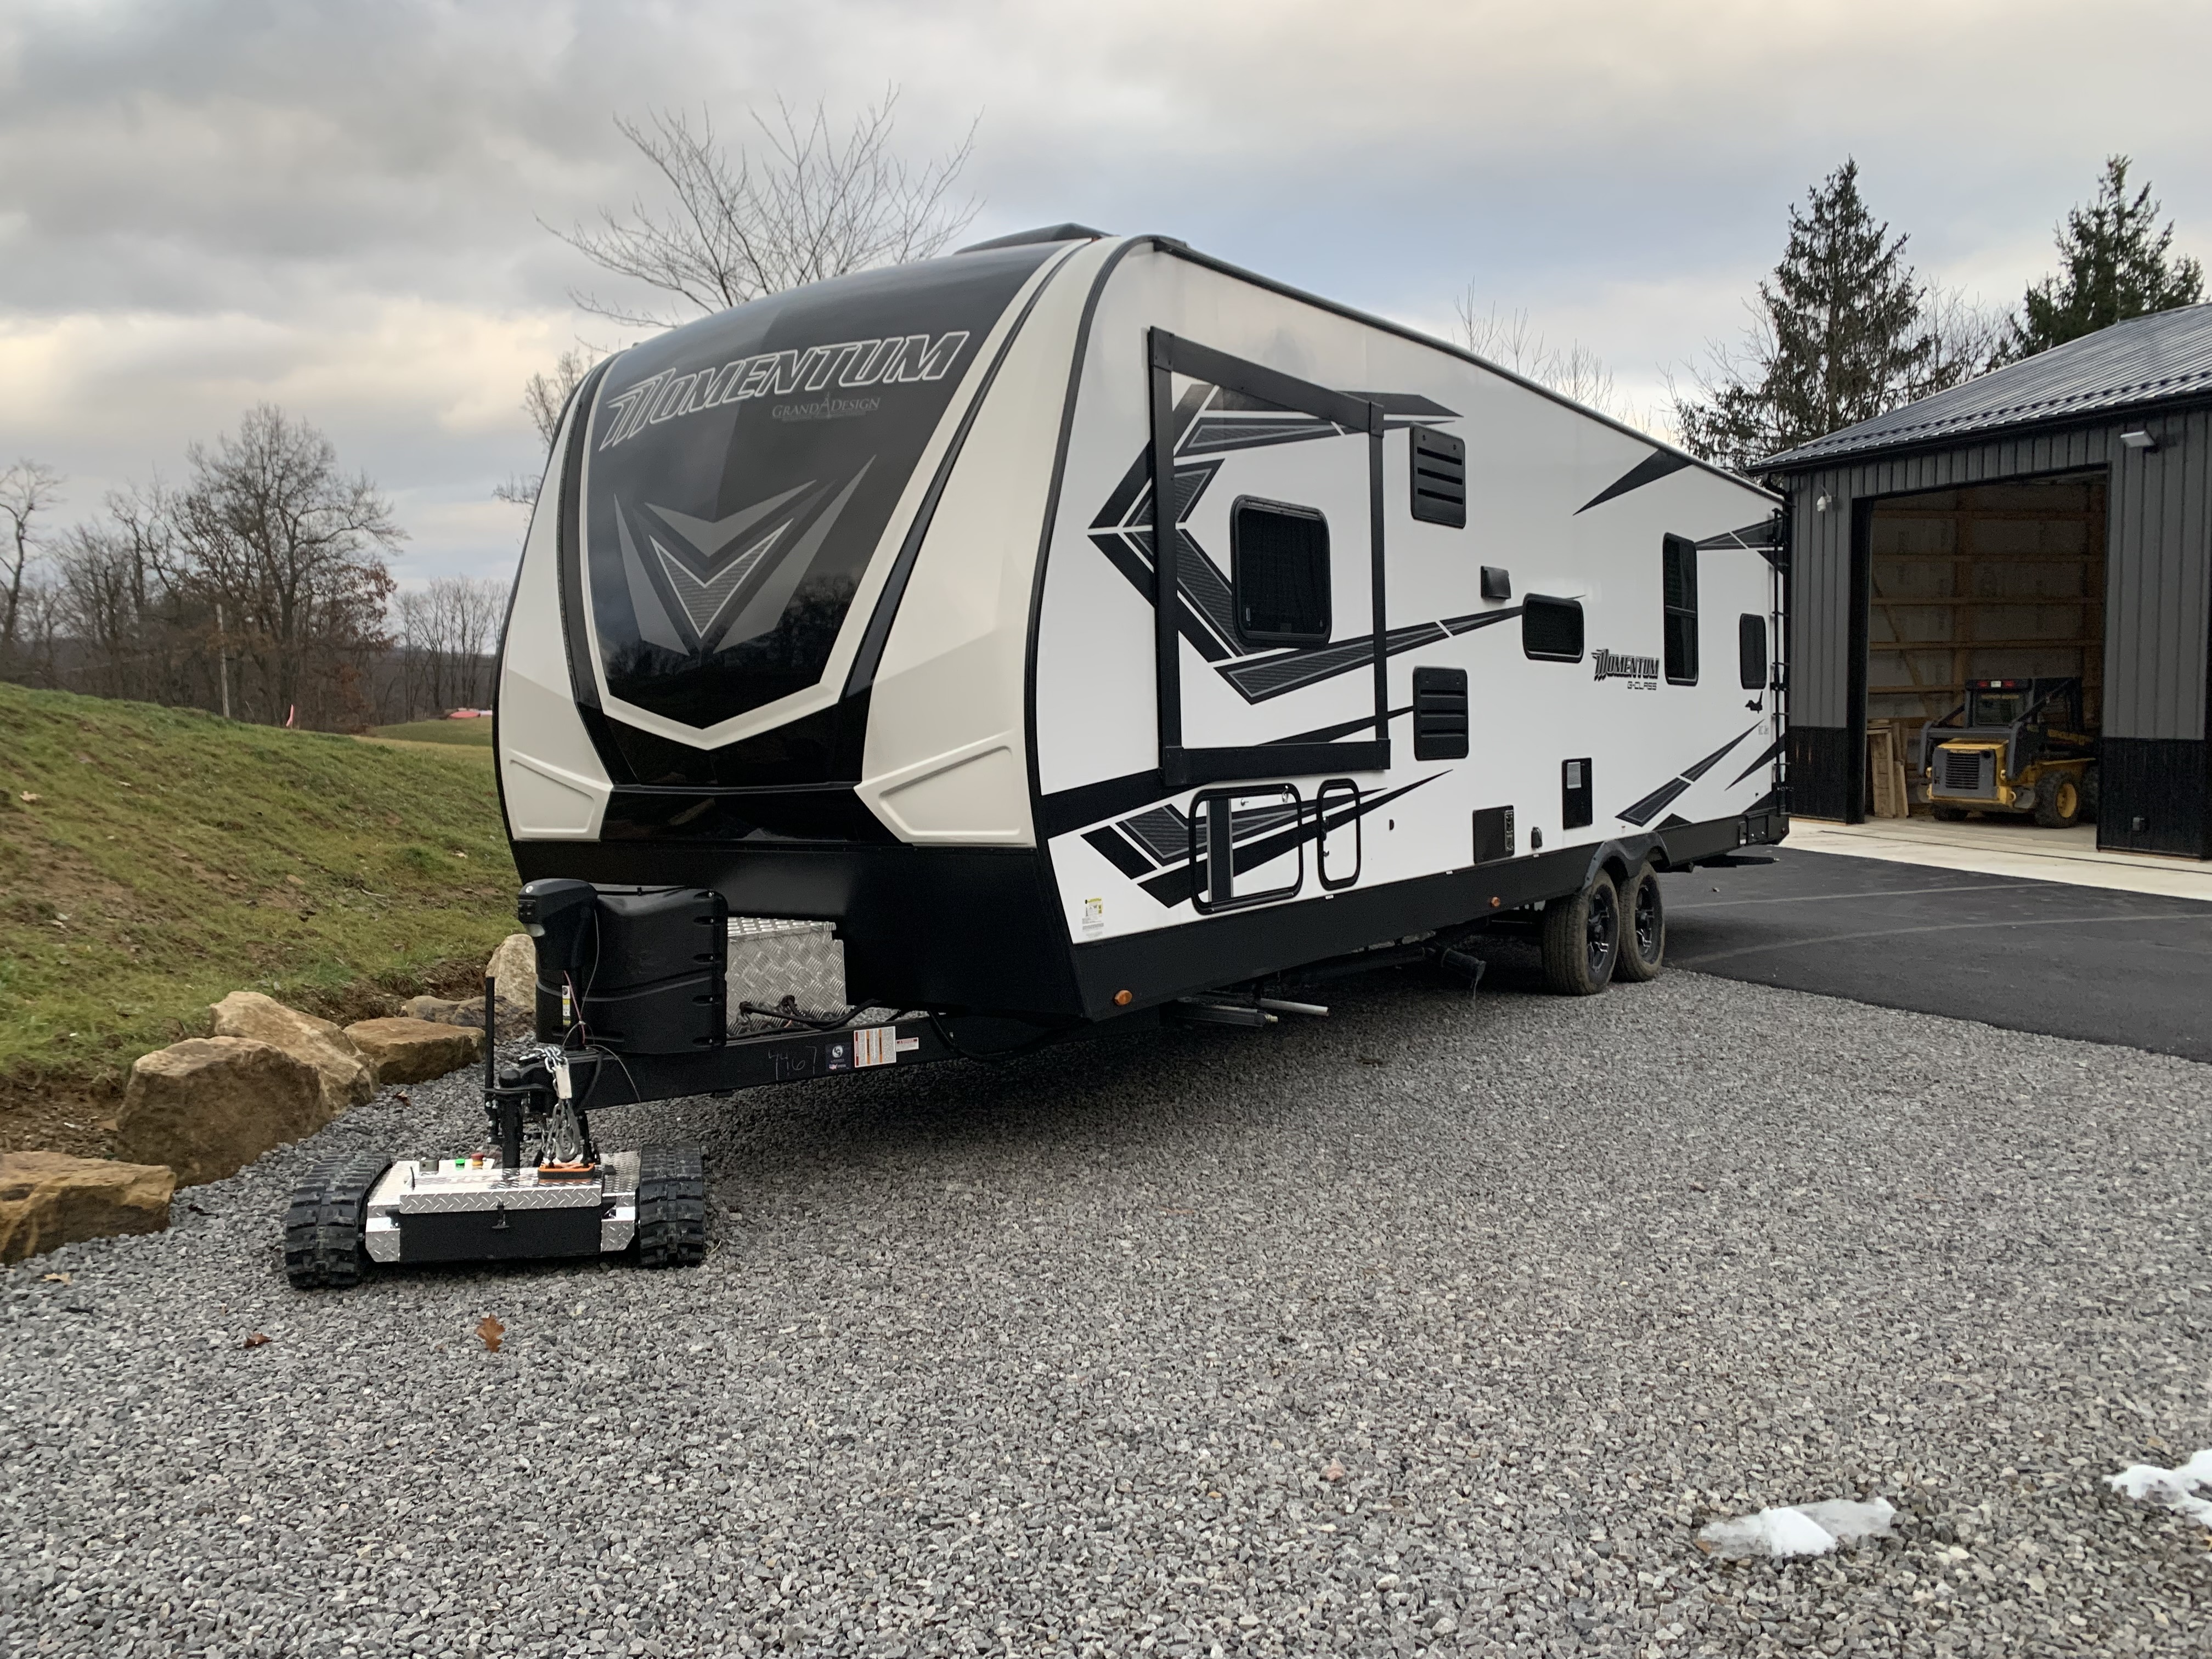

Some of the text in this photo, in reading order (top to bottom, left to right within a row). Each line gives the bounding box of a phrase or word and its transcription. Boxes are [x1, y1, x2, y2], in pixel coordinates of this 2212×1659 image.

[599, 331, 969, 452] MOMENTUM
[772, 402, 821, 419] GRAND
[831, 397, 881, 411] DESIGN
[1591, 648, 1660, 681] MOMENTUM
[1627, 681, 1657, 691] G-CLASS
